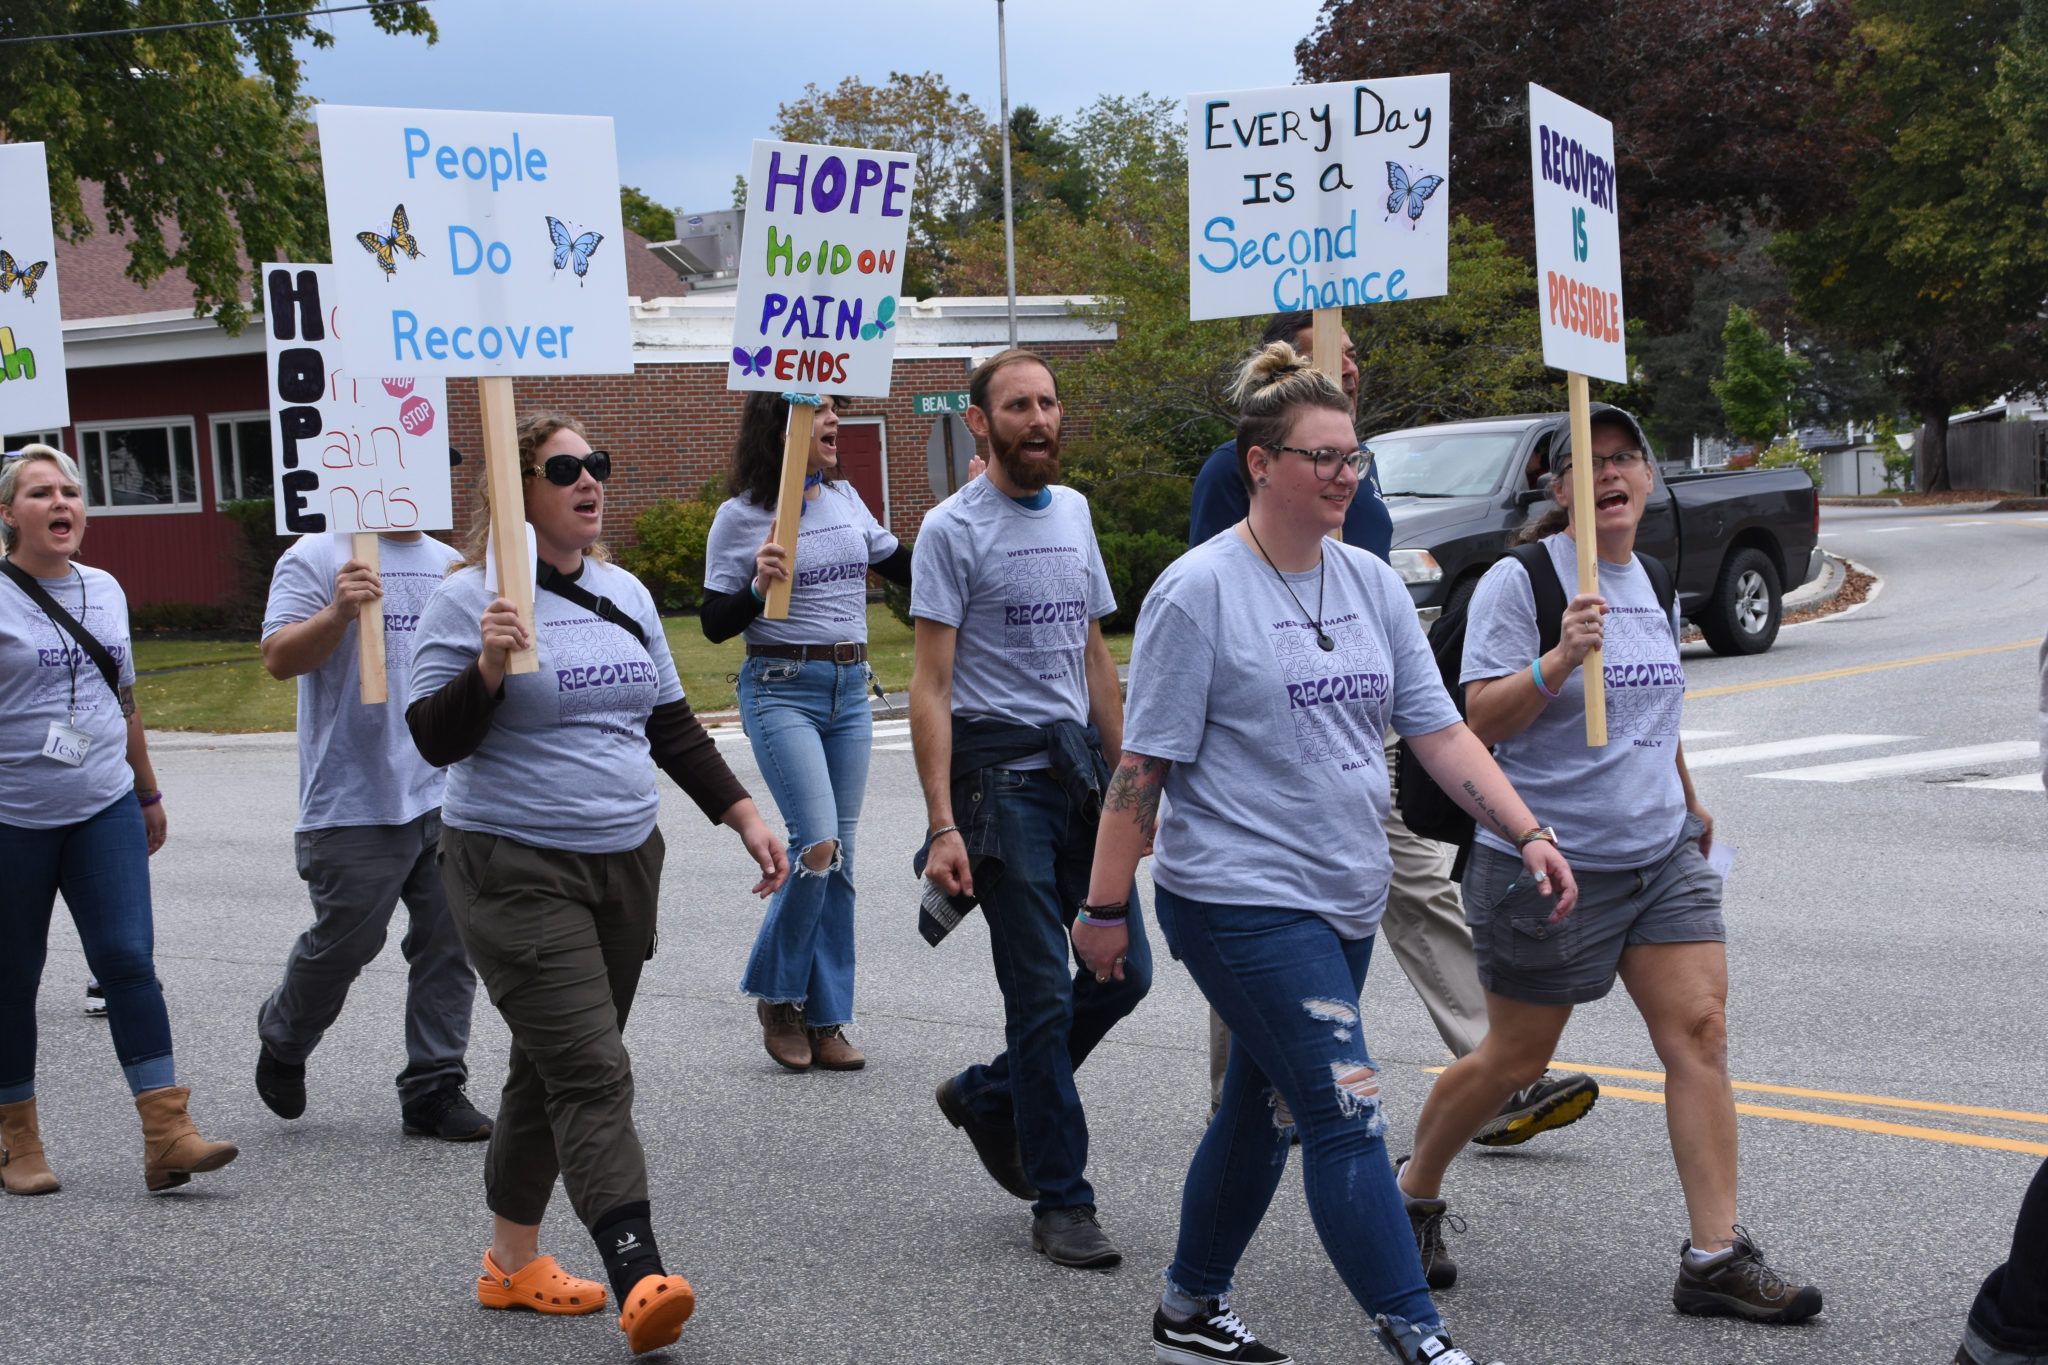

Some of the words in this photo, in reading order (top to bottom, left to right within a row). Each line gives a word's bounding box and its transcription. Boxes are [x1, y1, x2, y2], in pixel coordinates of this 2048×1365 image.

[1354, 86, 1432, 148] Day
[404, 127, 548, 192] People
[1319, 162, 1353, 192] a
[1539, 124, 1616, 214] RECOVERY
[765, 151, 910, 217] HOPE
[448, 225, 512, 275] Do
[1198, 209, 1357, 273] Second
[1572, 206, 1588, 262] IS
[1273, 267, 1408, 312] Chance
[1548, 270, 1620, 344] POSSIBLE
[760, 293, 863, 341] PAIN
[392, 310, 574, 360] Recover
[774, 348, 850, 384] ENDS
[402, 402, 430, 431] STOP
[922, 396, 951, 412] BEAL
[1007, 547, 1053, 557] WESTERN
[543, 618, 593, 627] WESTERN
[1004, 600, 1086, 626] RECOVERY
[1325, 613, 1359, 627] MAIN
[556, 662, 658, 691] RECOVERY
[1039, 671, 1067, 680] RALLY
[1286, 674, 1388, 709] RECOVERY
[47, 736, 84, 761] Jess
[1342, 758, 1371, 771] RALLY
